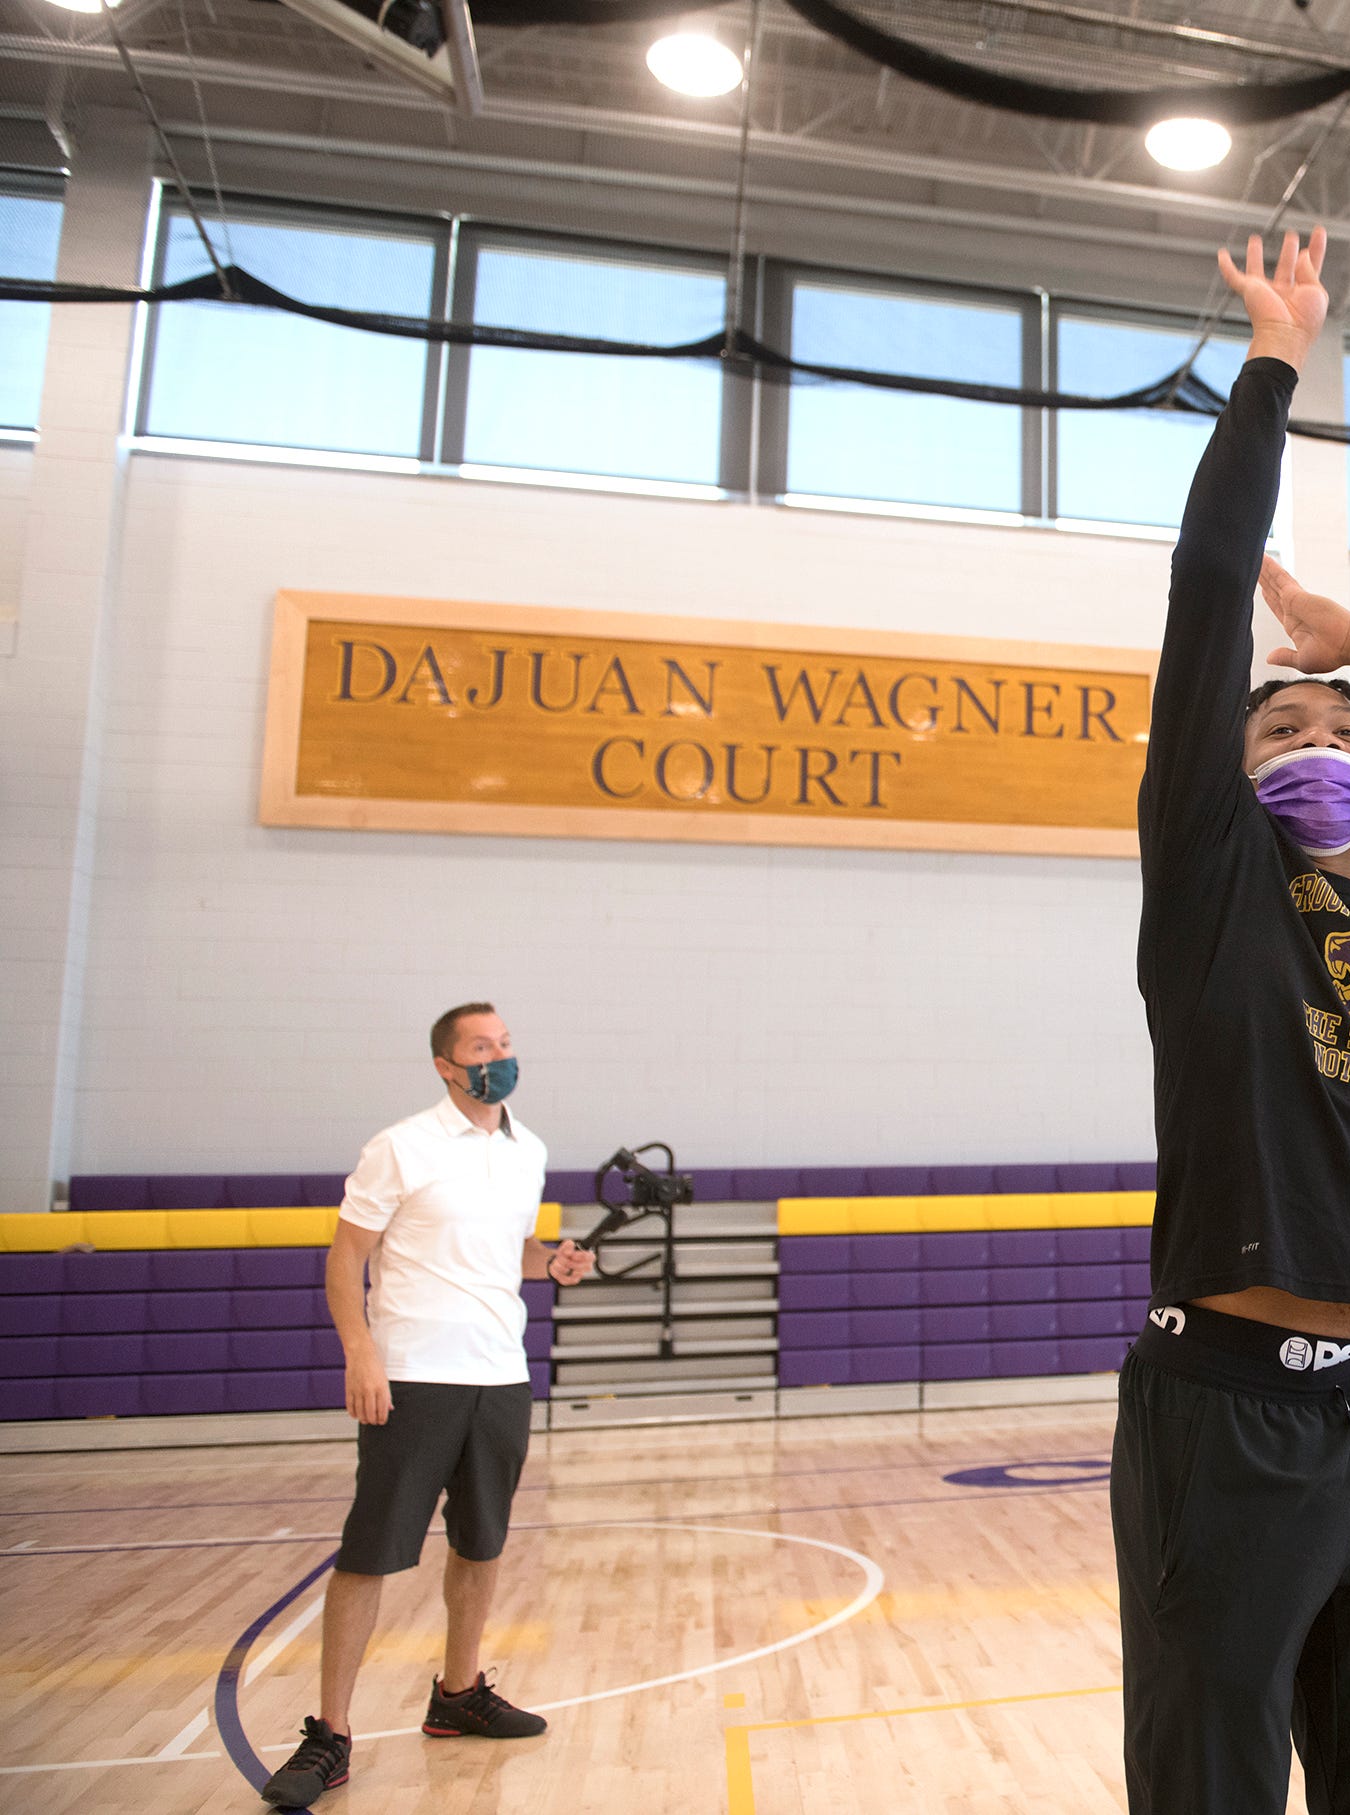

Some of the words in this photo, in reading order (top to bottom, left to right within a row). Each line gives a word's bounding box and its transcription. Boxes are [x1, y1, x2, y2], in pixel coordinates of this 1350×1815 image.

[337, 638, 718, 717] DAJUAN
[763, 663, 1125, 744] WAGNER
[592, 737, 902, 808] COURT
[1289, 873, 1350, 917] GROU
